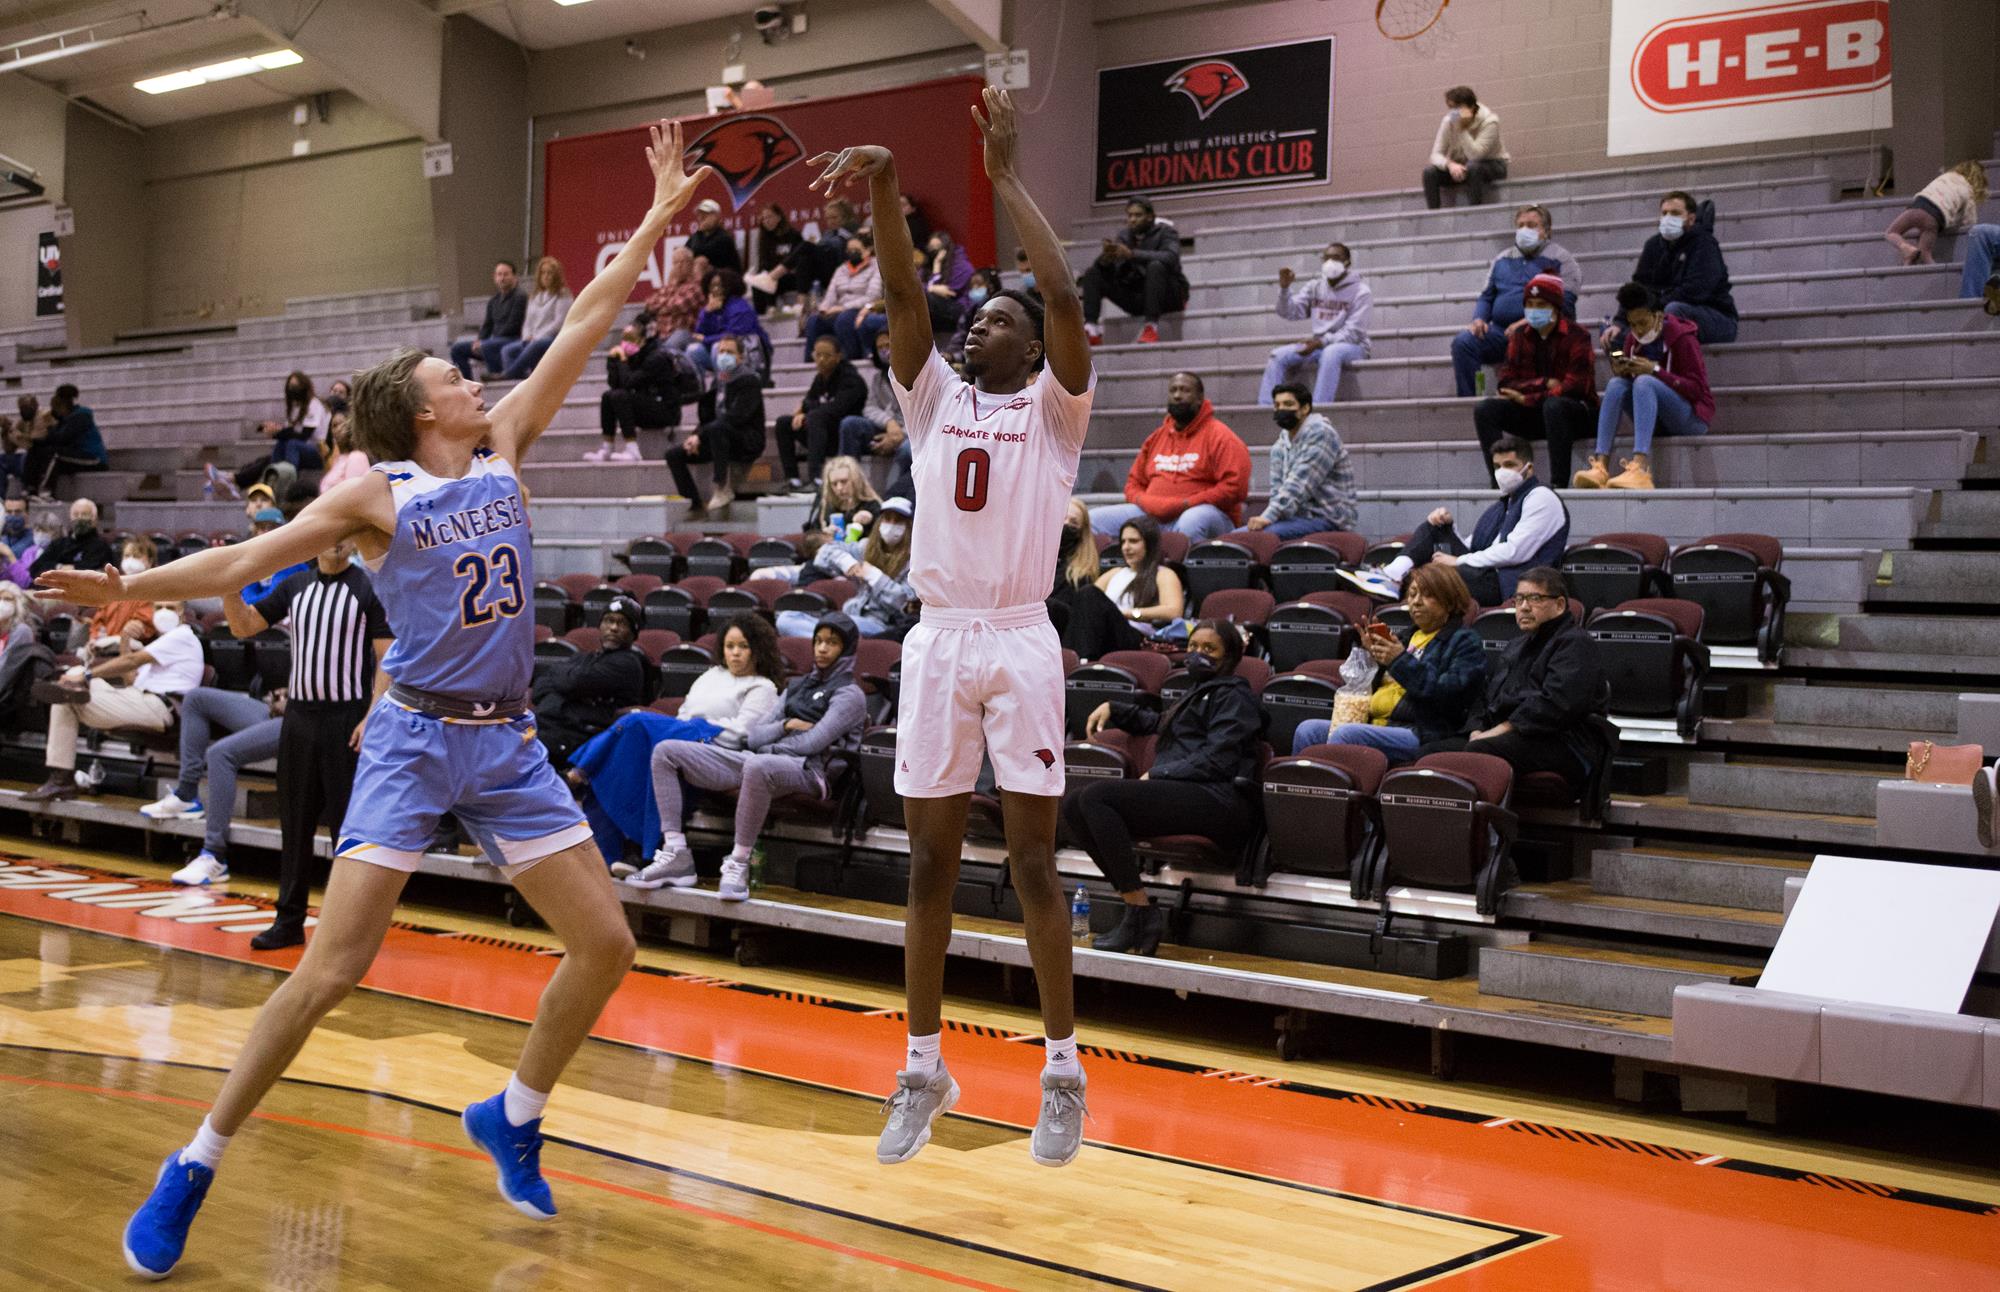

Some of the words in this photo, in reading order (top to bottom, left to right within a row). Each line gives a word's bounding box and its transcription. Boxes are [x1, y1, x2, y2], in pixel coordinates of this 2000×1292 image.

[1666, 18, 1884, 90] H-E-B
[1002, 70, 1013, 84] C
[1145, 142, 1168, 155] THE
[1174, 139, 1200, 152] UIW
[1206, 130, 1277, 147] ATHLETICS
[1106, 146, 1241, 190] CARDINALS
[1246, 139, 1313, 176] CLUB
[992, 432, 1028, 443] WORD
[954, 447, 991, 512] 0
[453, 543, 526, 629] 23
[1406, 797, 1431, 805] RESERVE
[1432, 799, 1458, 808] SEATING
